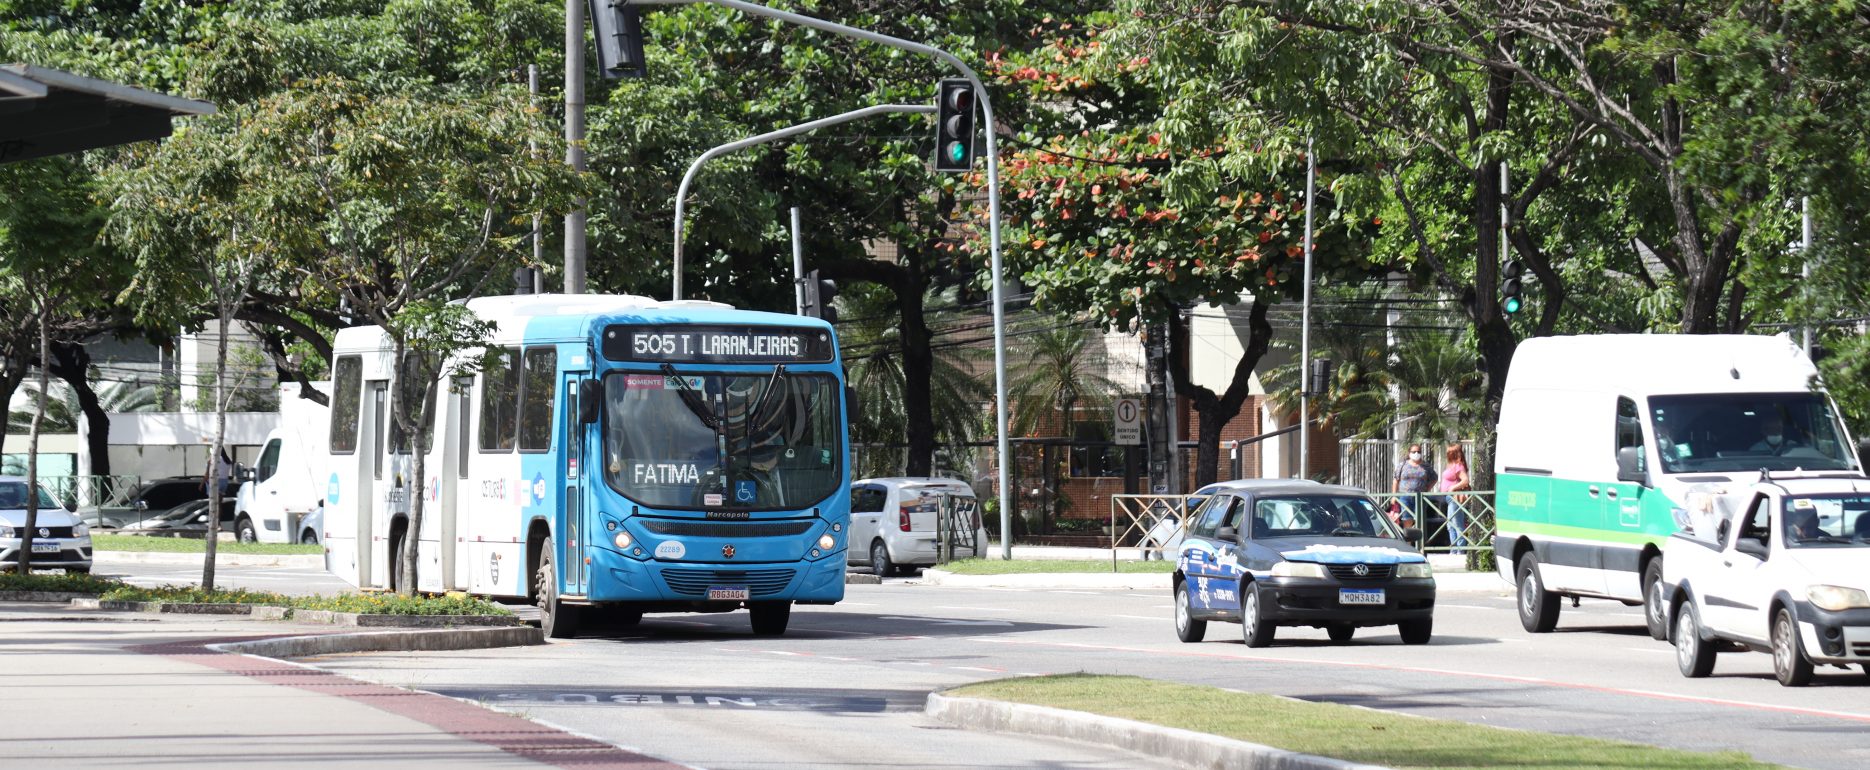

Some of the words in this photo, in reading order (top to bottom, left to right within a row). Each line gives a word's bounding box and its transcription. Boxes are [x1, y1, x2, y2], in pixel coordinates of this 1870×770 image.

[634, 334, 676, 354] 505
[681, 335, 694, 354] T.
[702, 335, 799, 356] LARANJEIRAS
[634, 464, 700, 484] FATIMA
[707, 511, 749, 519] Marcopolo
